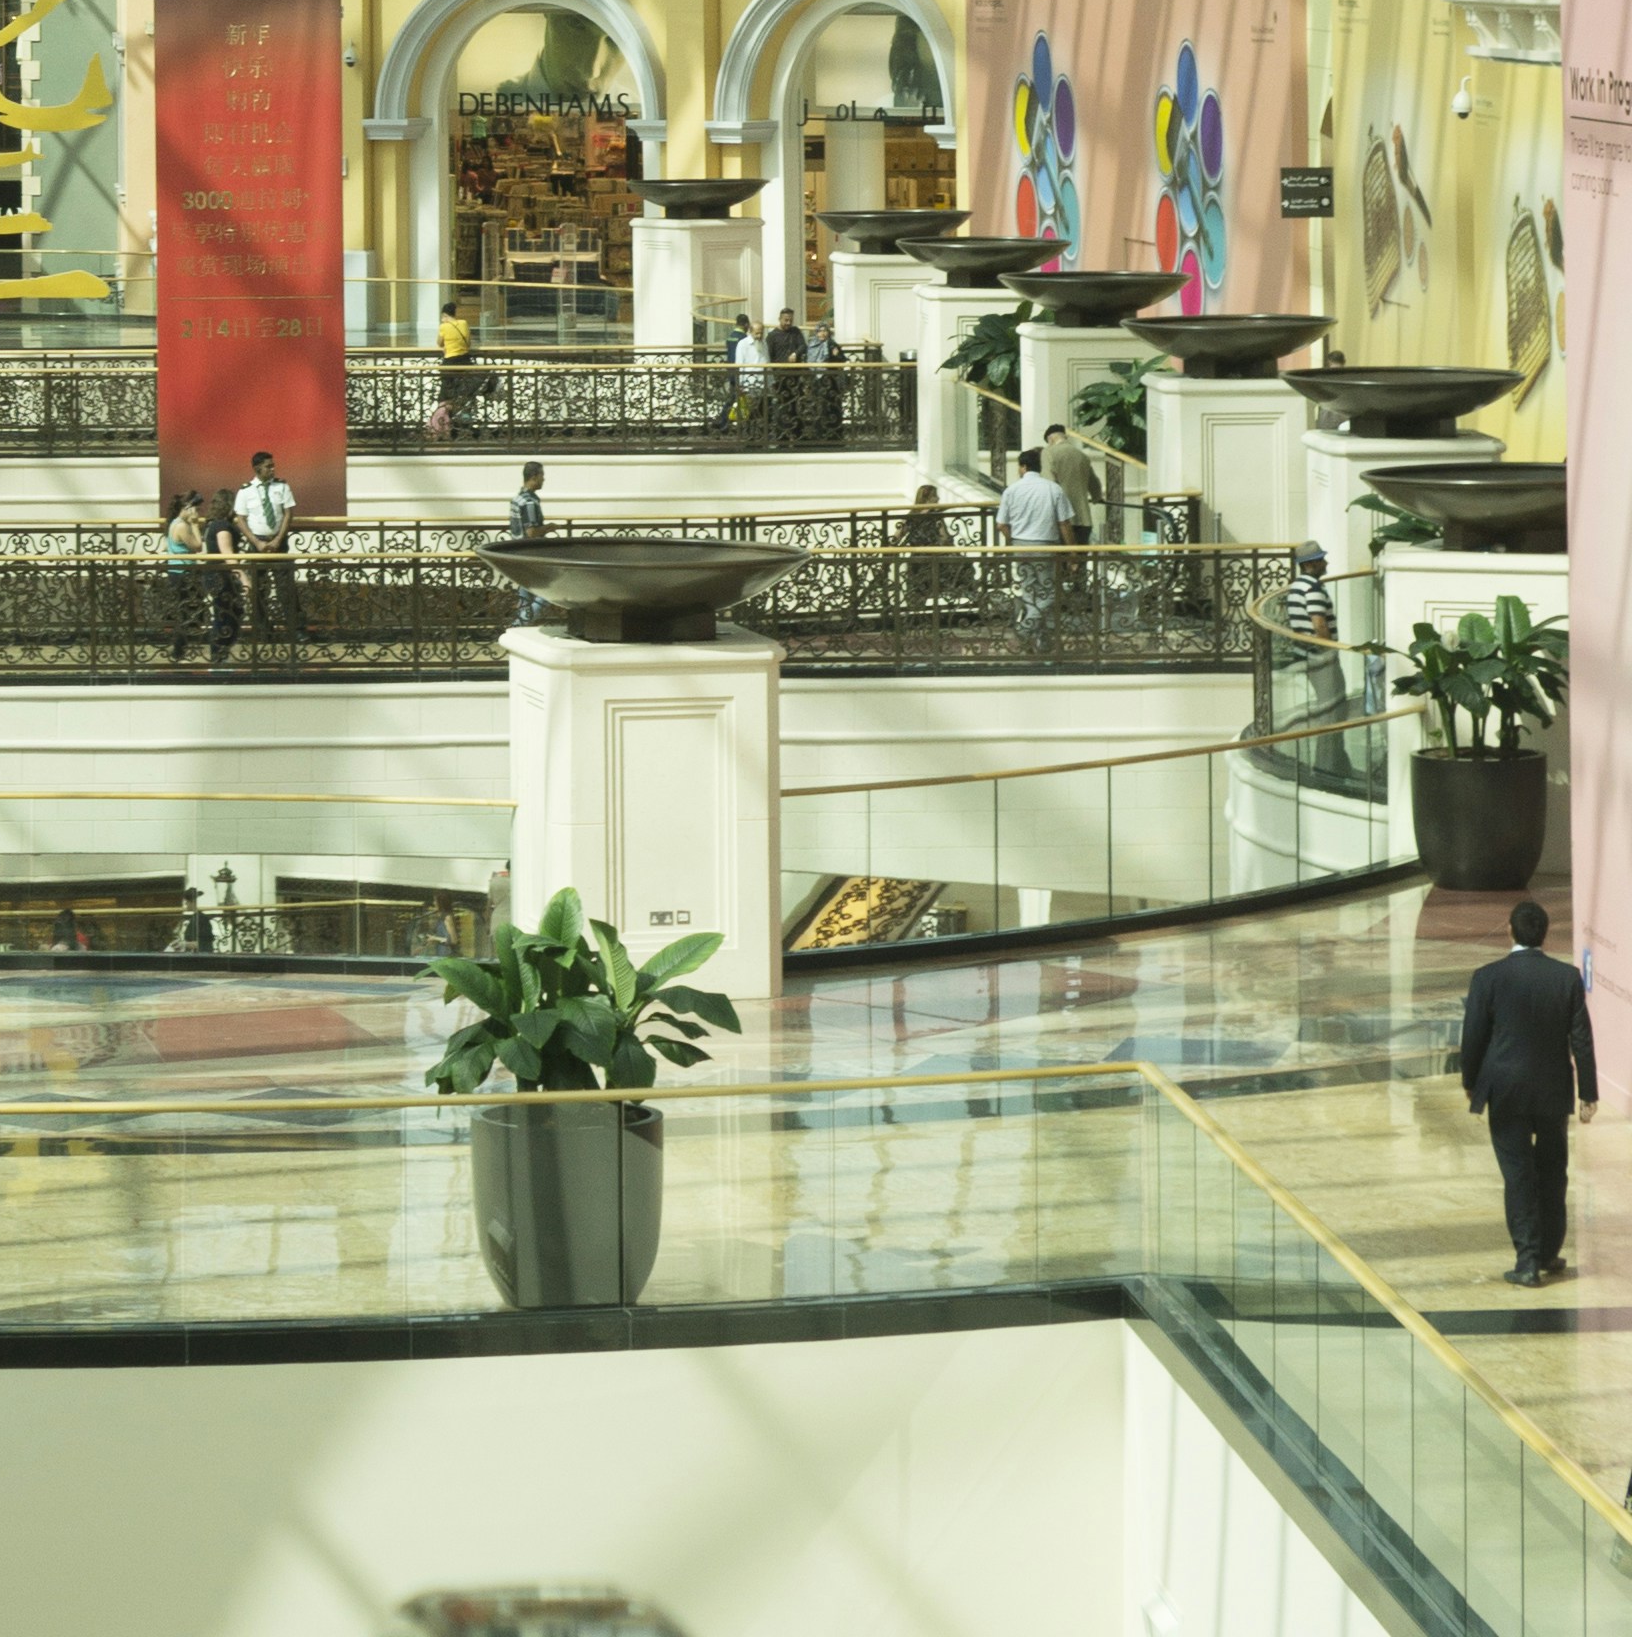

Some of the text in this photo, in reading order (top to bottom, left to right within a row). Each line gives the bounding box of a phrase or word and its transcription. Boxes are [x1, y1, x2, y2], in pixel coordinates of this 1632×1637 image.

[226, 24, 270, 46] 新年
[1569, 67, 1595, 102] Work
[1596, 68, 1607, 104] in
[458, 92, 631, 117] DEBENHAMS
